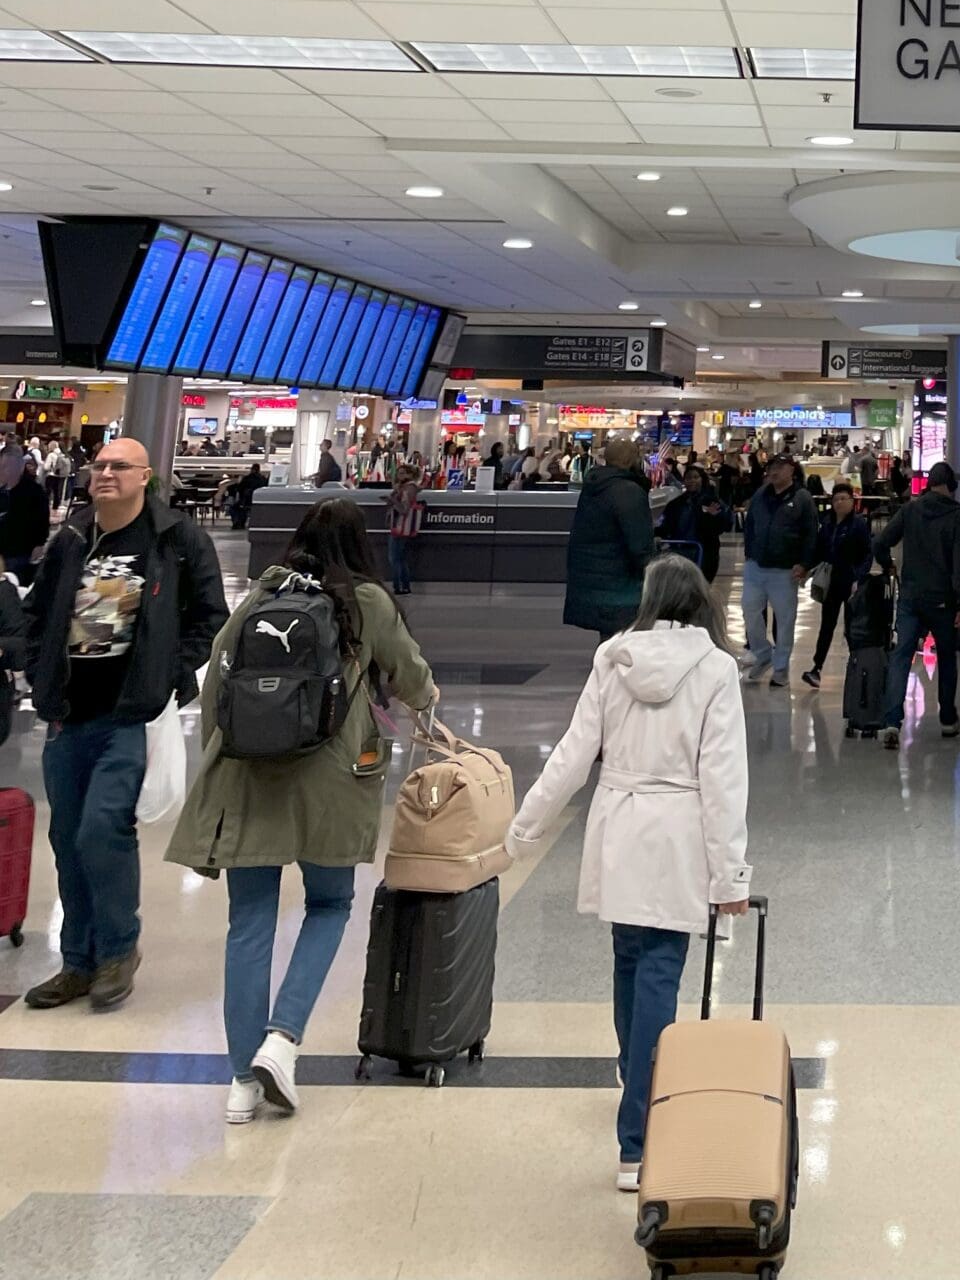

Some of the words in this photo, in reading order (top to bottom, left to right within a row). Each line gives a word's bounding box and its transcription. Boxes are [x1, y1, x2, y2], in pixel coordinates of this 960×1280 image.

[552, 337, 576, 346] Gates
[546, 352, 570, 361] Gates
[863, 350, 902, 358] Concourse
[862, 363, 910, 372] International
[755, 409, 826, 420] McDonald's
[427, 511, 494, 524] Information
